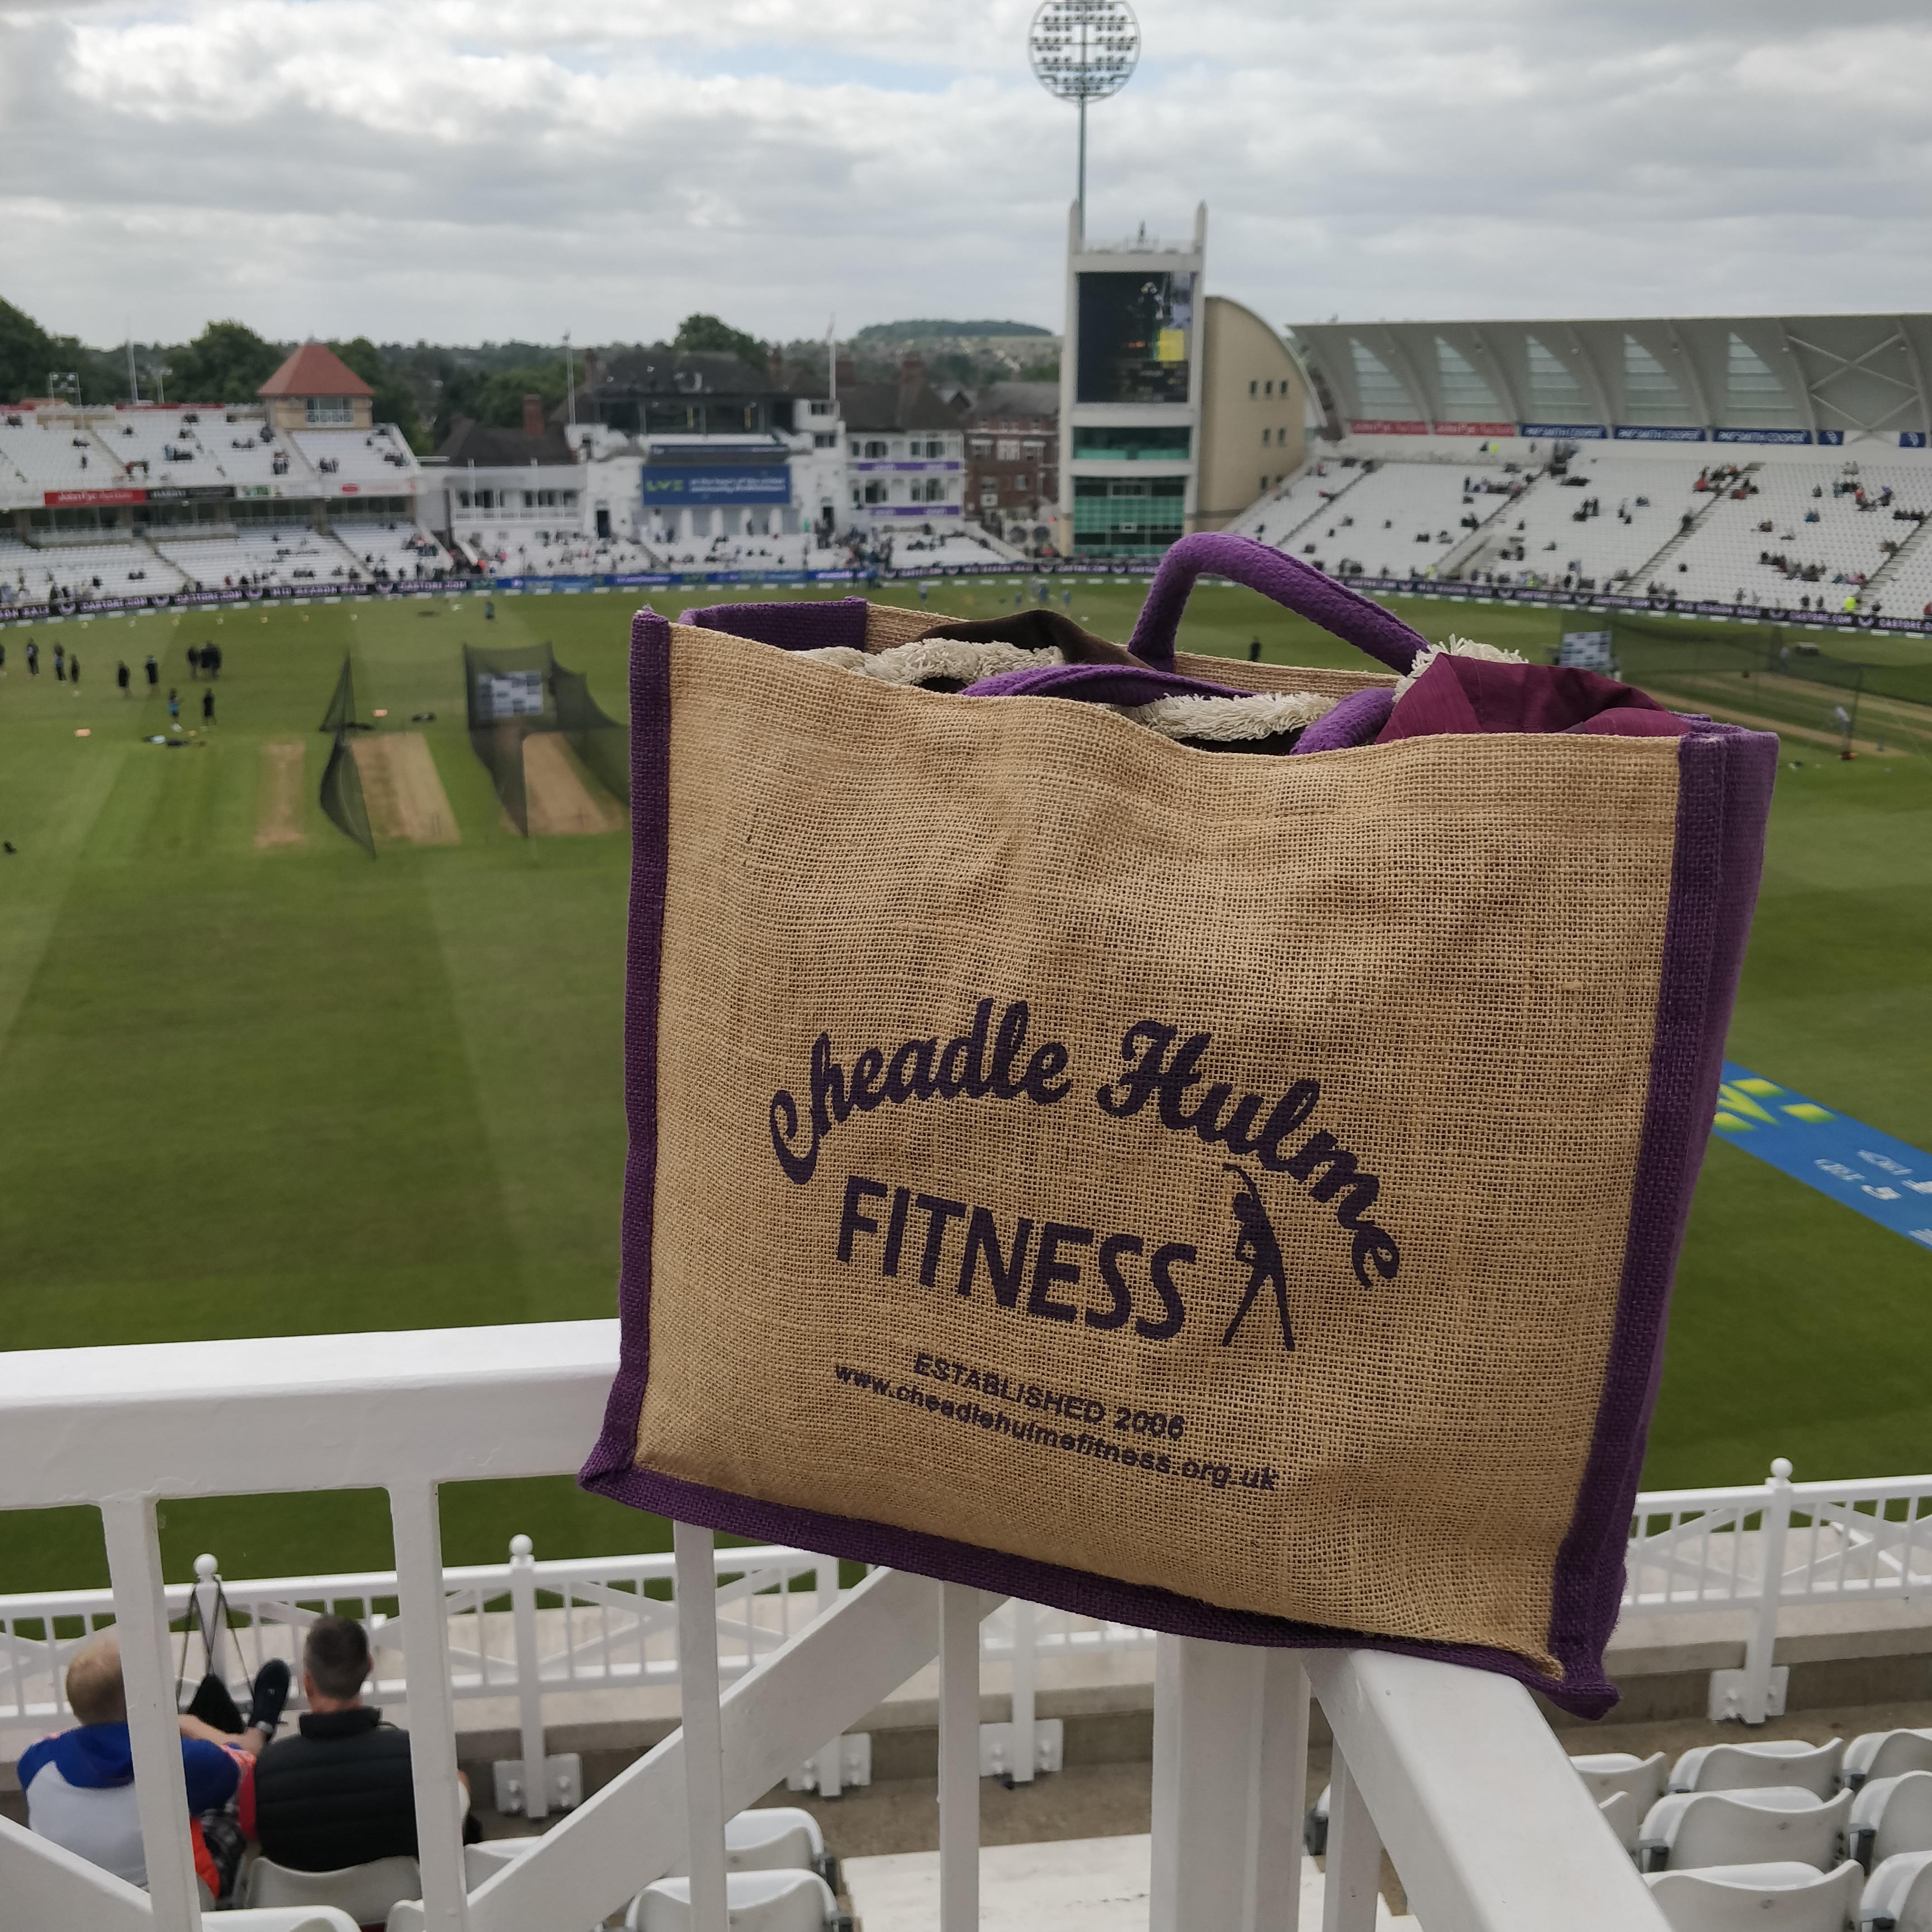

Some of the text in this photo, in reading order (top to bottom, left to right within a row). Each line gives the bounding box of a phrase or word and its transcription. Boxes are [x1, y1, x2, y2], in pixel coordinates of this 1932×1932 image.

[770, 998, 1400, 1289] Cheadle Hulme
[837, 1176, 1196, 1341] FITNESS
[836, 1364, 1279, 1491] www.cheadlehulmefitness.org.uk
[915, 1352, 1185, 1440] ESTABLISHED 2006
